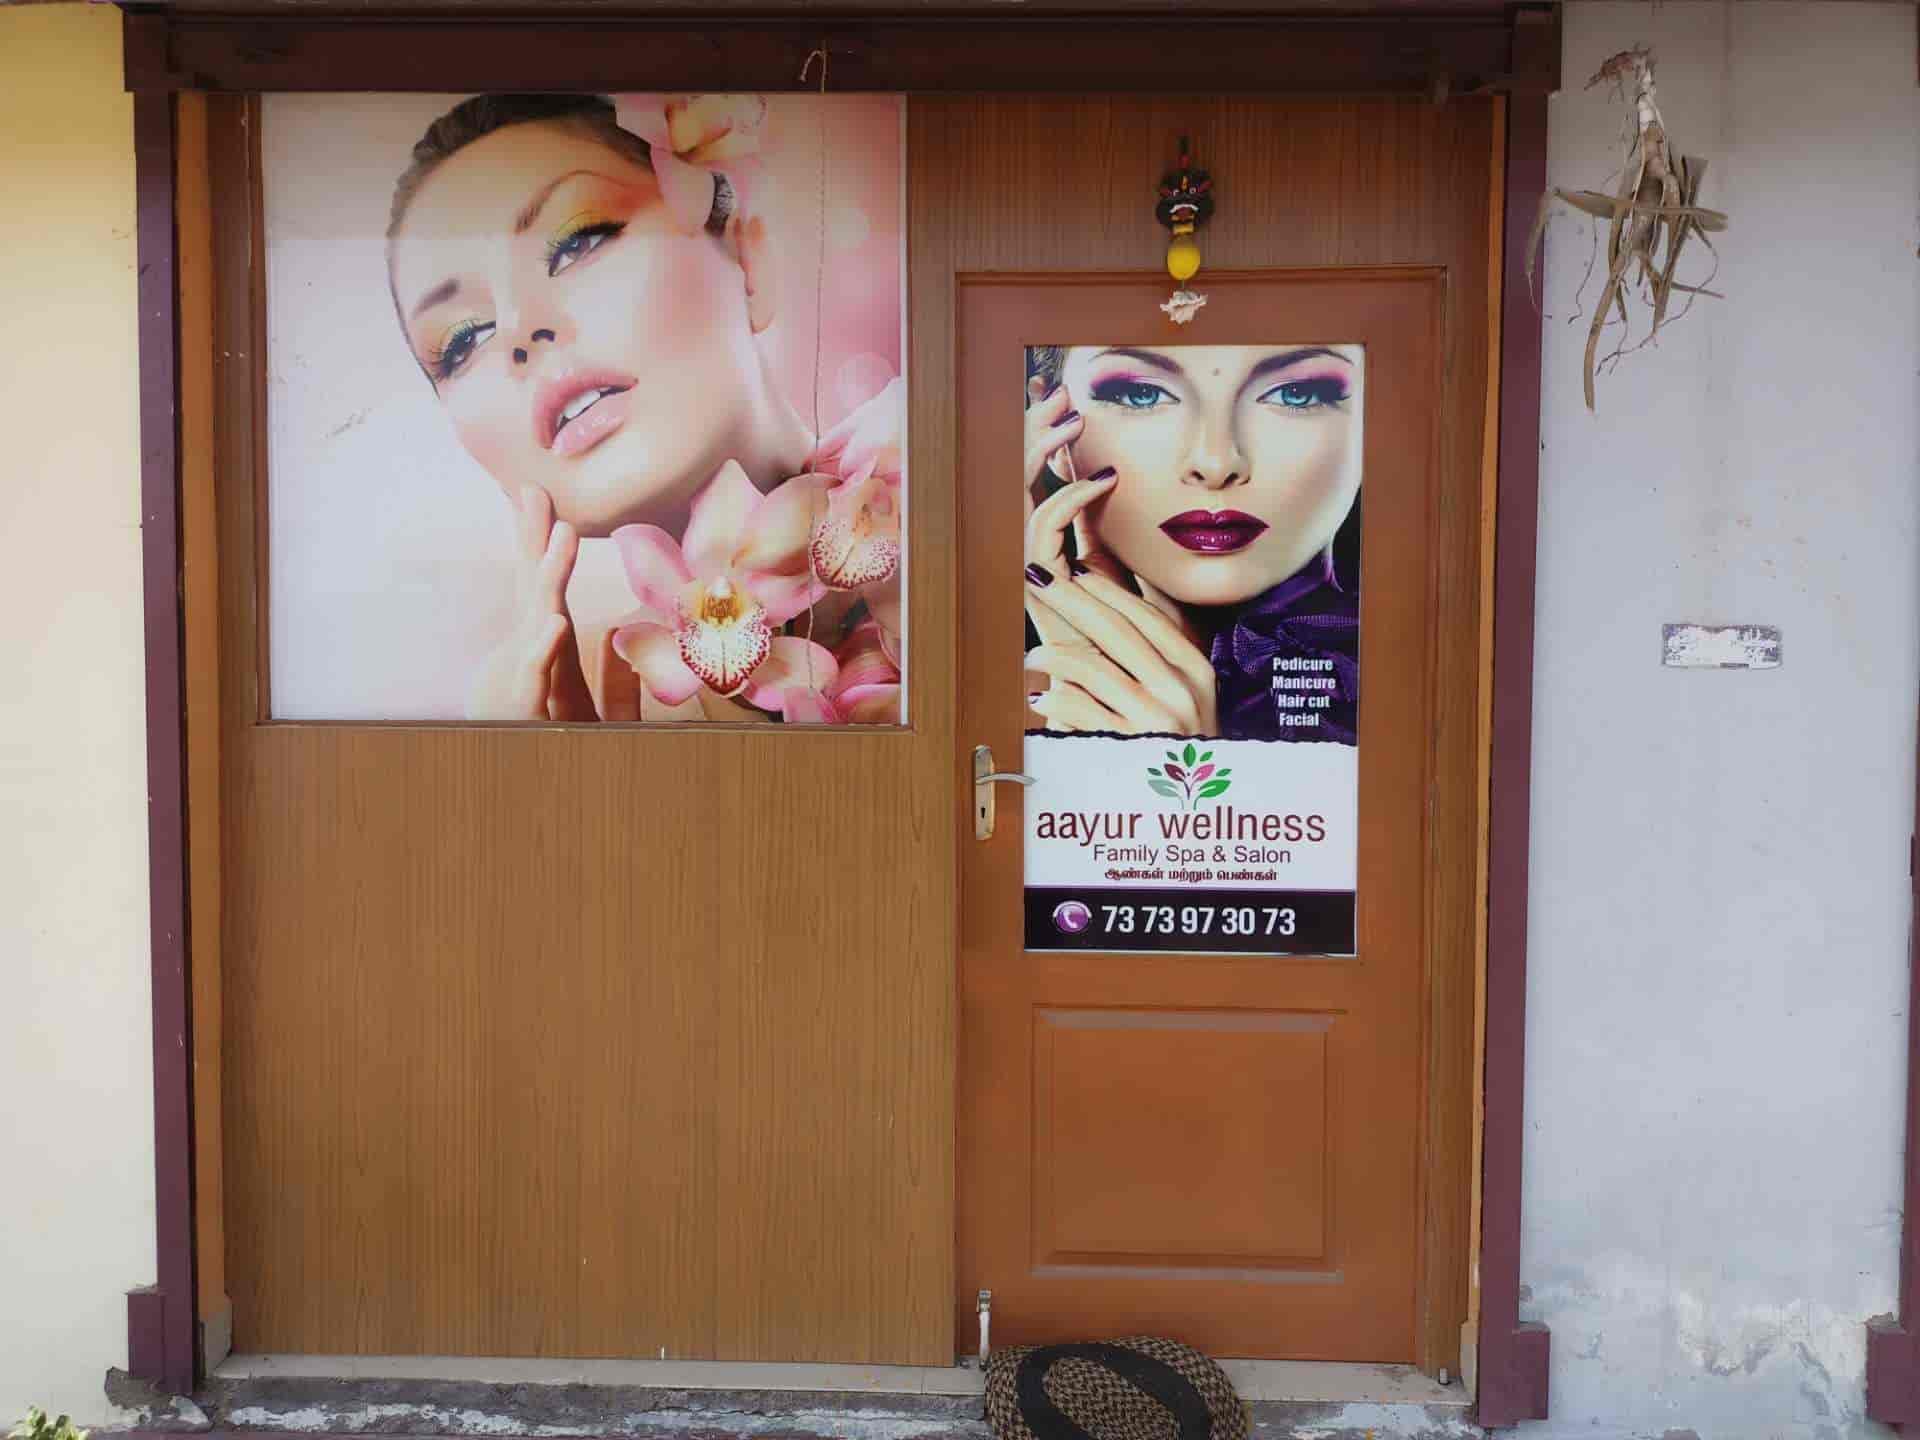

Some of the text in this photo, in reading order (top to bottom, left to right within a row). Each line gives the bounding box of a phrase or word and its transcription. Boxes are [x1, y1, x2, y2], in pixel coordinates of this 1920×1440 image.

[1272, 657, 1334, 671] Pedicure
[1272, 675, 1336, 689] Manicure
[1277, 694, 1331, 708] Hair cut
[1279, 712, 1319, 726] Facial
[1036, 806, 1326, 847] aayur wellness
[1093, 844, 1291, 866] Family Spa & Salon
[1104, 868, 1278, 882] ஆண்கள் மற்றும் பெண்கள்
[1101, 905, 1296, 936] 73 73 97 30 73
